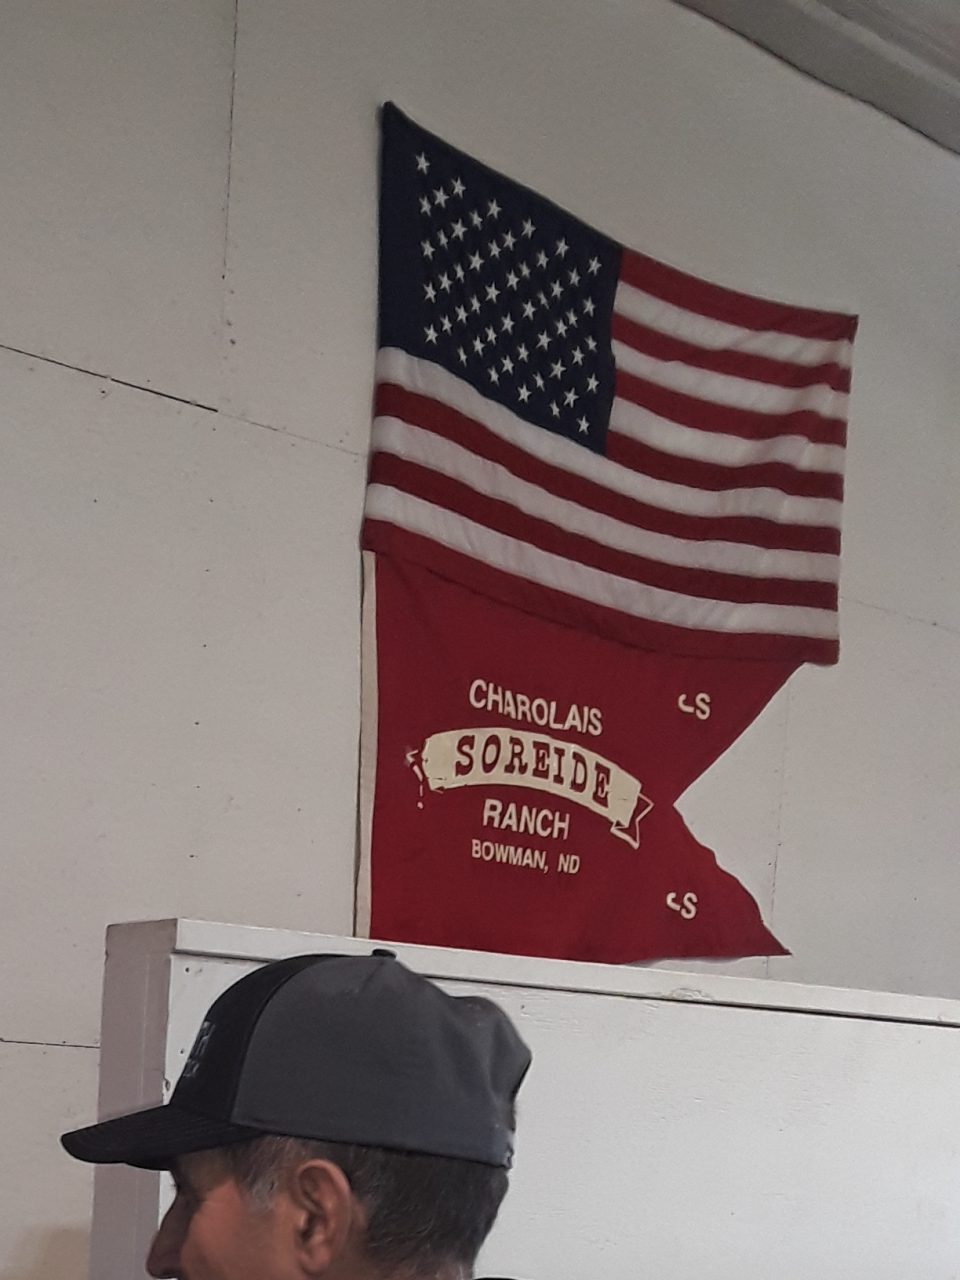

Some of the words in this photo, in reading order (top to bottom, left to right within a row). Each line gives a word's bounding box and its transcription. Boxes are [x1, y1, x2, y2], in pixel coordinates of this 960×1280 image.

[468, 678, 603, 736] CHAROLAIS
[454, 734, 611, 808] SOREIDE
[482, 798, 570, 840] RANCH
[471, 838, 549, 873] BOWMAN,
[557, 852, 581, 875] ND
